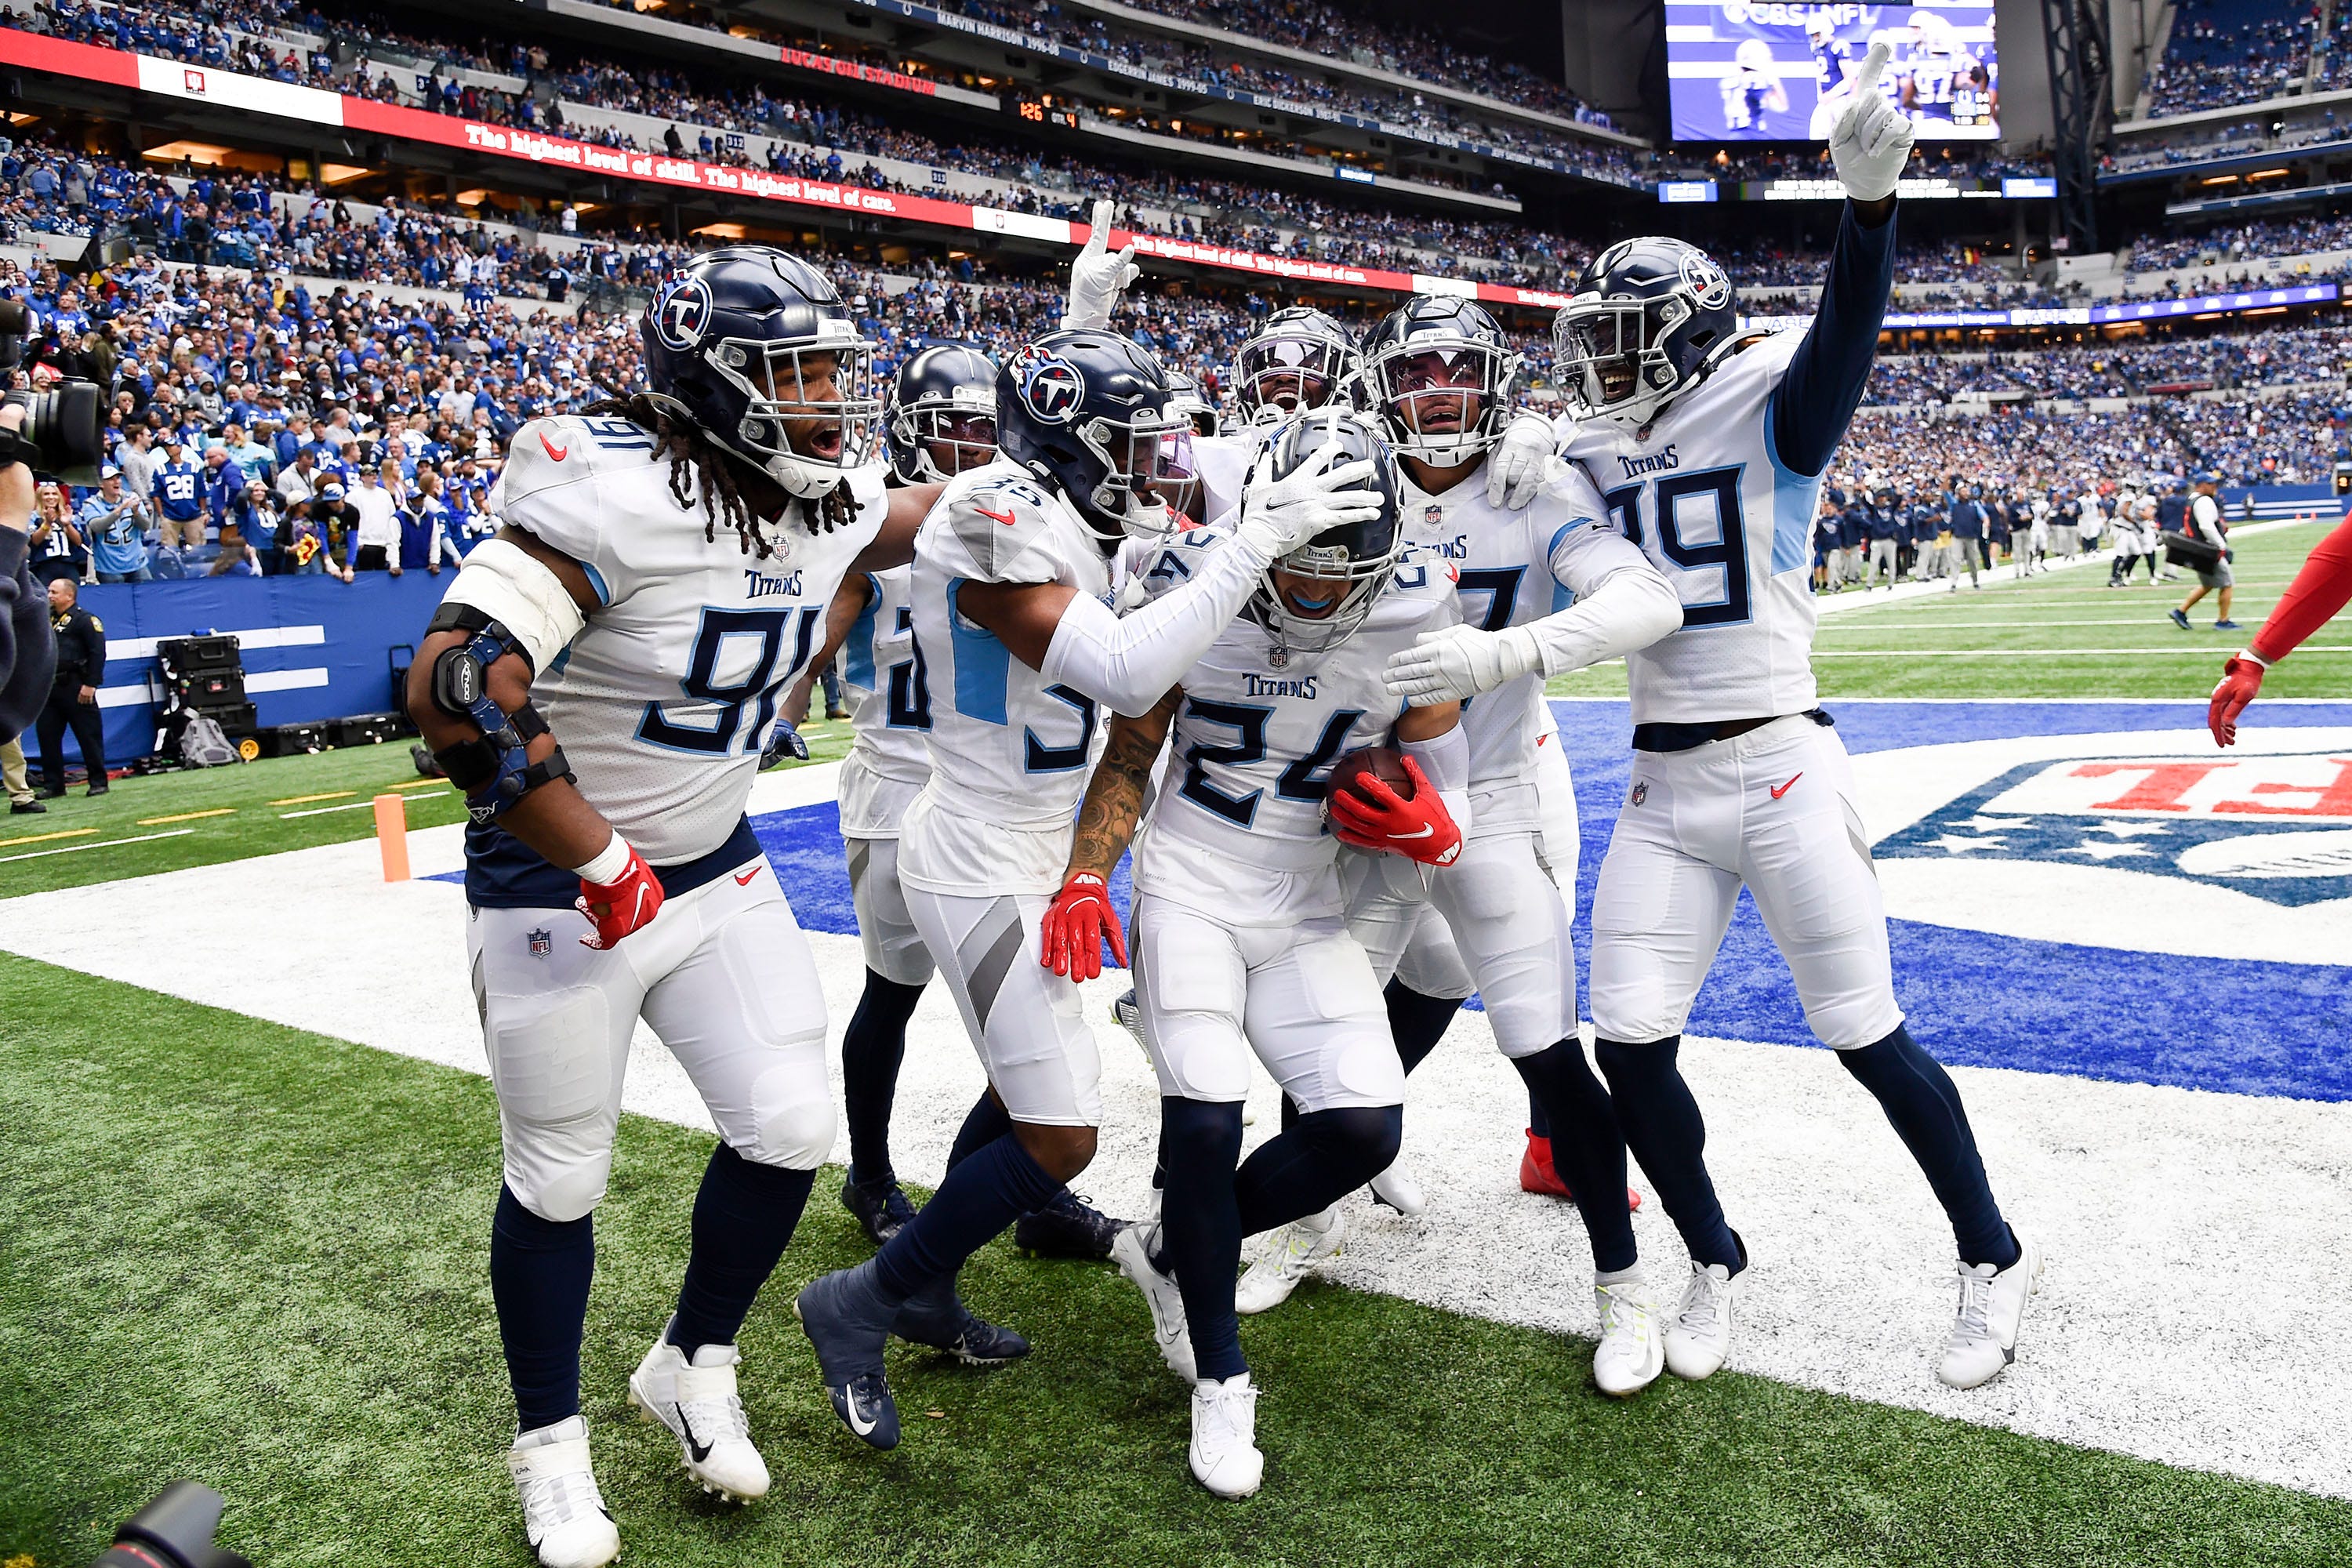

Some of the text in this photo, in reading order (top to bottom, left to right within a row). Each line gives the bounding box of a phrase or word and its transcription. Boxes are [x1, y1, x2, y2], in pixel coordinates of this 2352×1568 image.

[937, 13, 975, 33] MARVIN
[977, 22, 1022, 45] HARRISON
[781, 47, 936, 96] LUCAS OIL STADIUM
[728, 136, 744, 148] 312
[465, 124, 897, 212] The highest level of skill. The highest level of care.
[1421, 329, 1448, 338] TITANS
[579, 418, 655, 452] 91
[1617, 444, 1678, 480] TITANS
[165, 474, 194, 500] 28
[45, 529, 71, 557] 31
[1306, 546, 1334, 559] TITANS
[745, 568, 803, 599] TITANS
[633, 604, 824, 757] 91
[1241, 673, 1318, 700] TITANS
